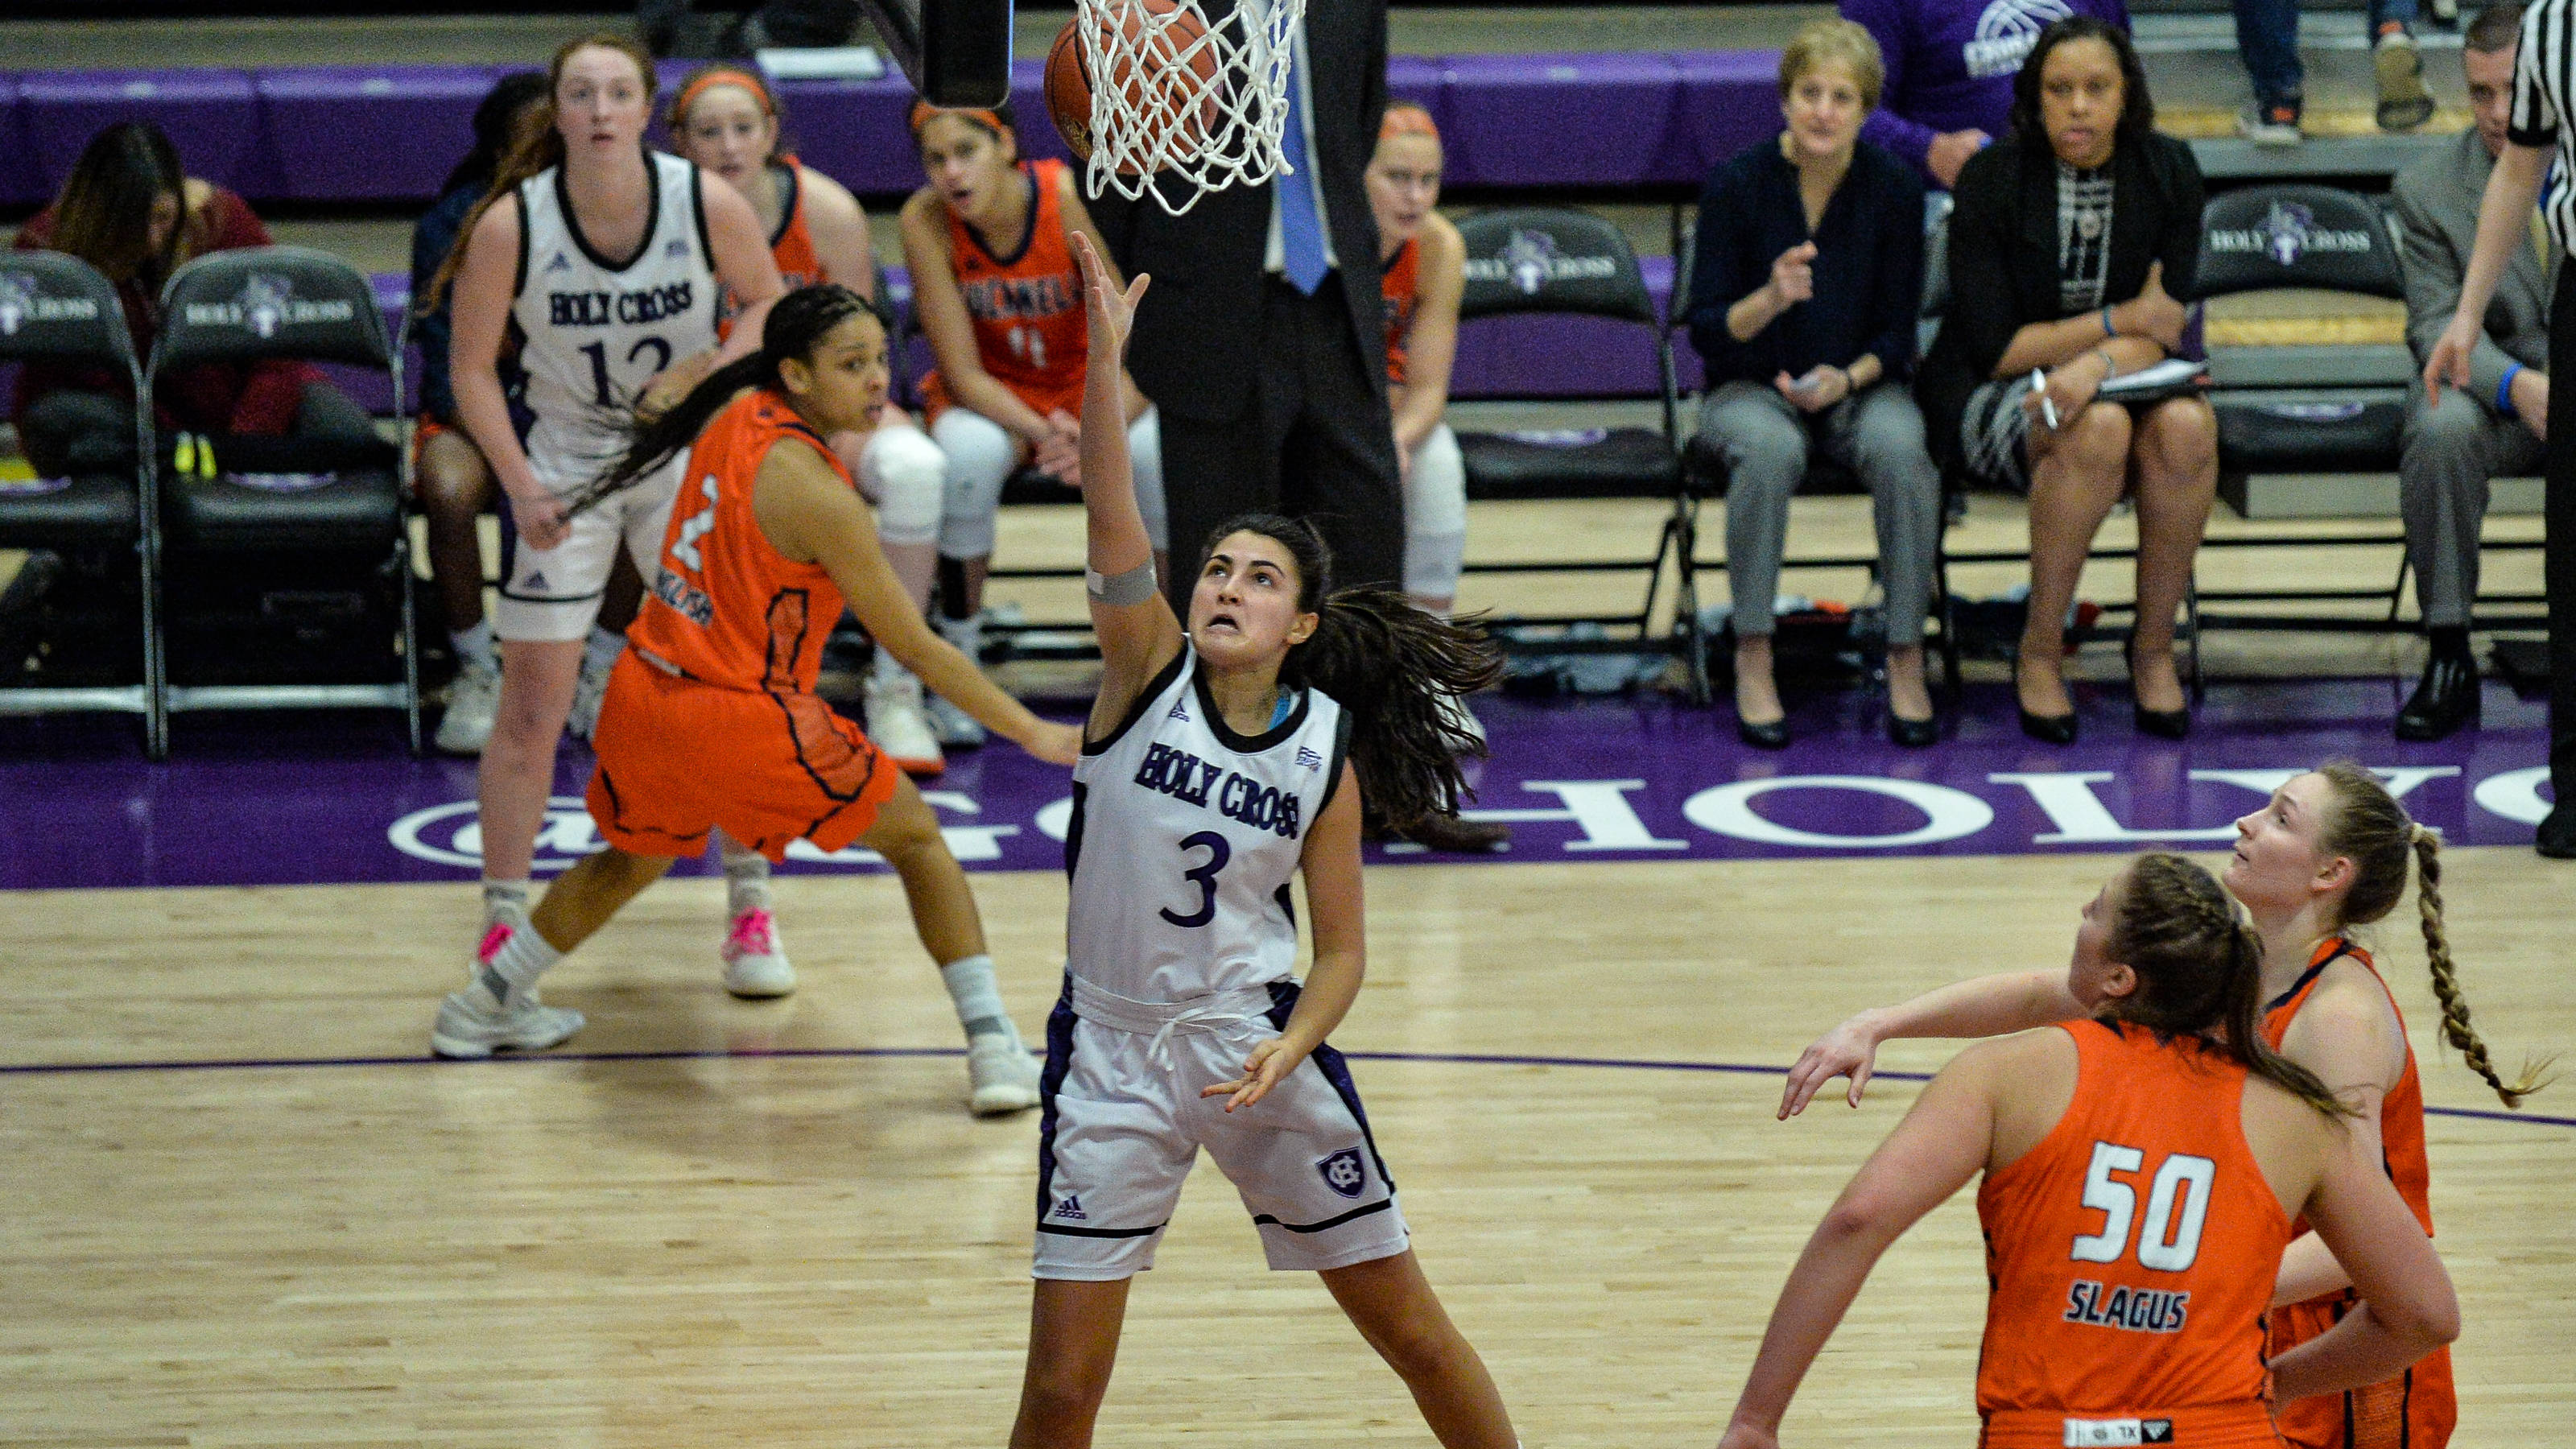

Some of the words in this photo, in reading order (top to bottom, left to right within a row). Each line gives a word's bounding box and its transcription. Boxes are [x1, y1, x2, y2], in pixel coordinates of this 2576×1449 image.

[550, 291, 610, 325] HOLY
[617, 282, 693, 324] CROSS
[579, 335, 672, 408] 12
[671, 473, 720, 573] 2
[1134, 741, 1223, 808] HOLY
[1220, 771, 1301, 840] CROSS
[1159, 830, 1231, 928] 3
[2070, 1140, 2216, 1272] 50
[2063, 1279, 2191, 1334] SLAGUS
